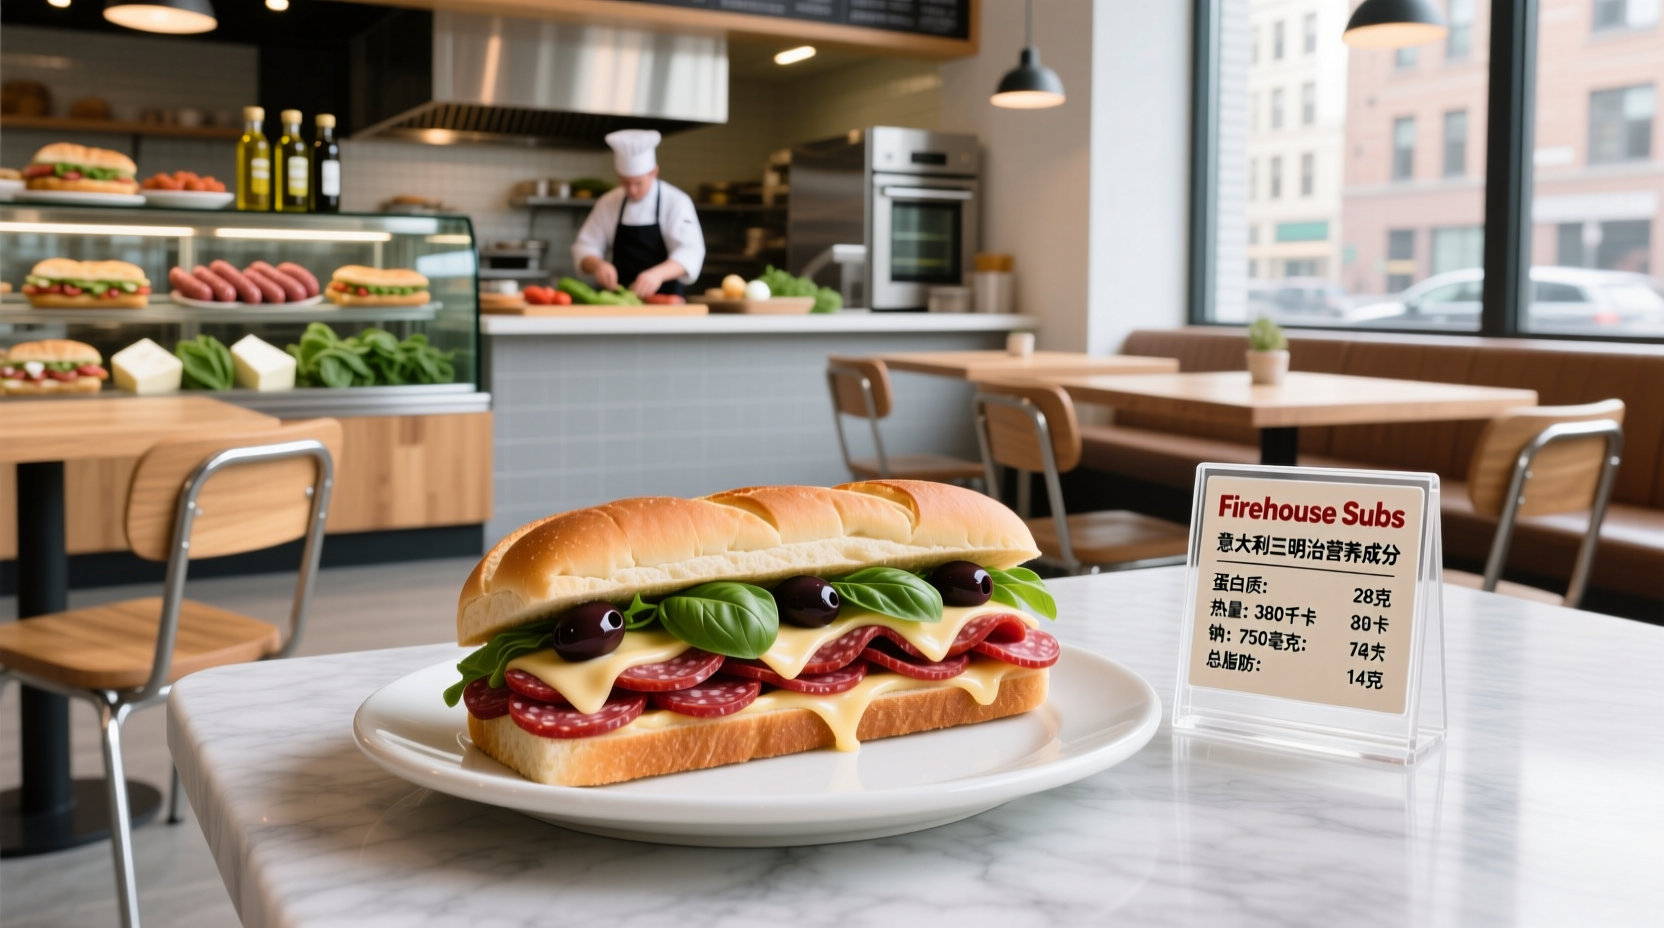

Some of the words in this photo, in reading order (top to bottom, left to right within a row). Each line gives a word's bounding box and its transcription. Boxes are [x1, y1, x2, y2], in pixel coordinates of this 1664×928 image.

[1219, 495, 1337, 524] Firehouse
[1342, 501, 1405, 528] Subs
[1217, 532, 1400, 566] 意大利三明治营养成分
[1353, 588, 1391, 608] 28克
[1255, 604, 1316, 626] 380千卡
[1347, 669, 1383, 689] 14克
